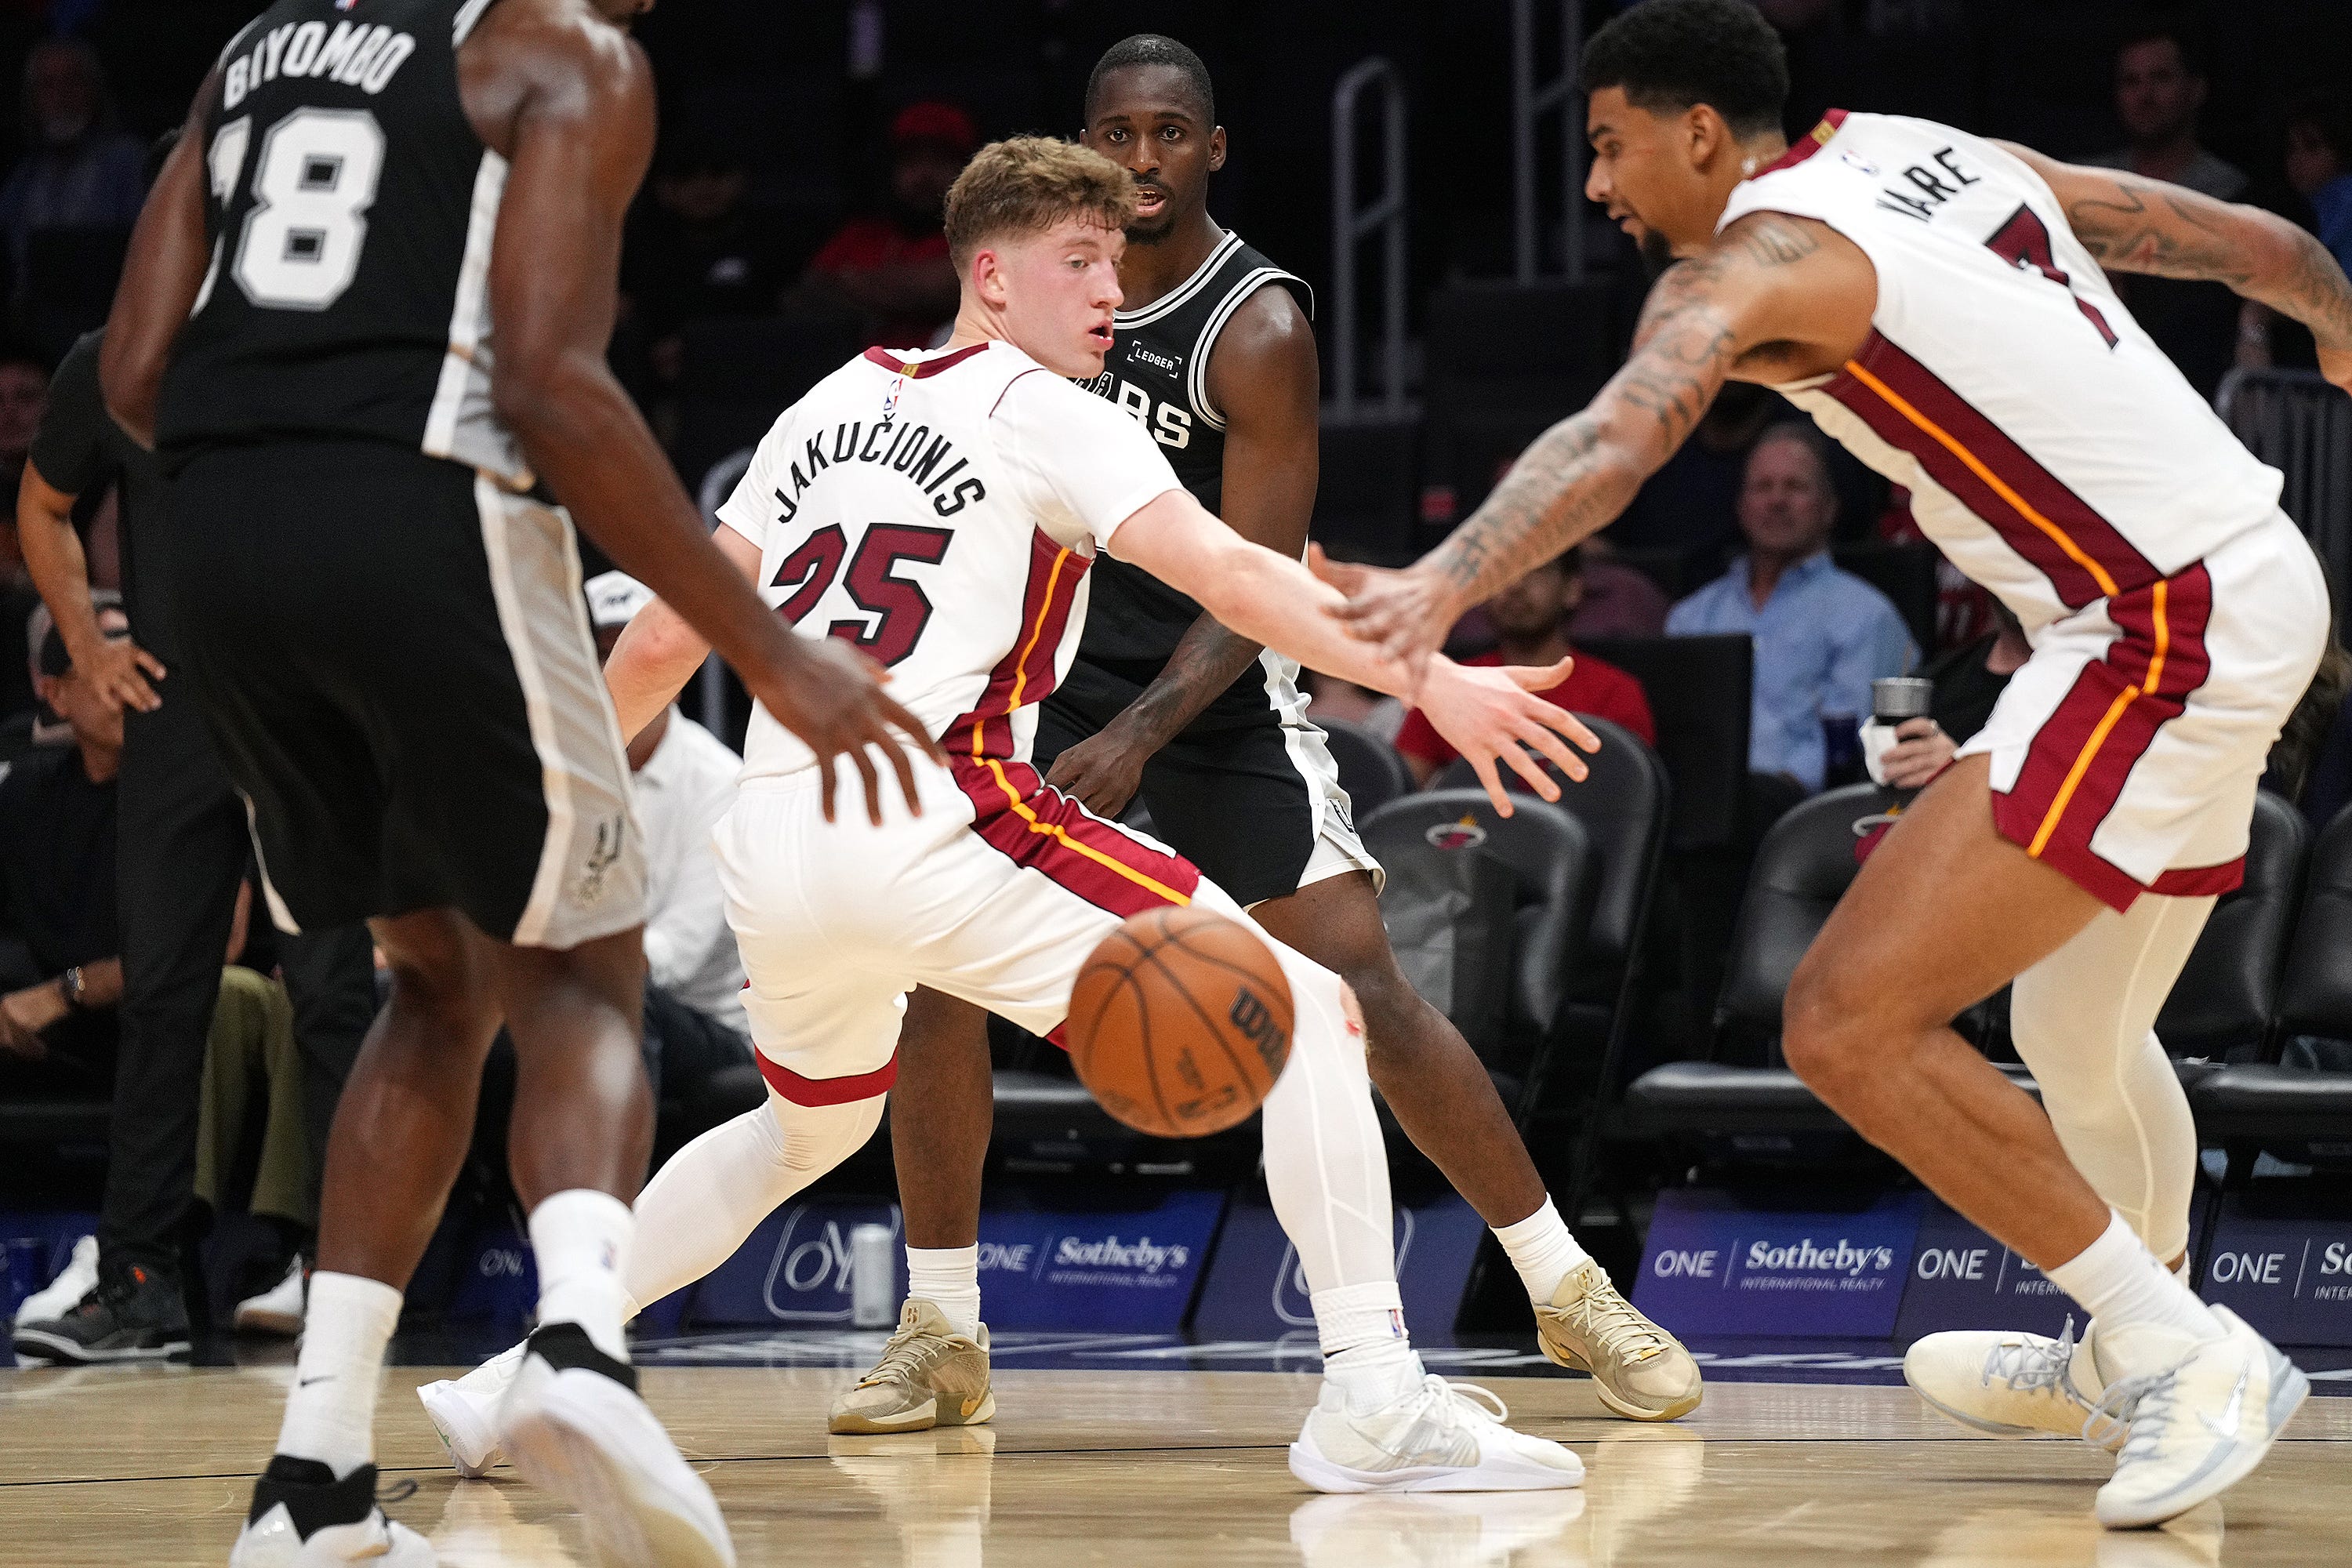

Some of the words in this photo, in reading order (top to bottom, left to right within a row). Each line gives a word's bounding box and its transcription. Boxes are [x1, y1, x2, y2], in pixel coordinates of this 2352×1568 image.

[224, 20, 416, 110] BIYOMBO
[1134, 347, 1175, 372] LEDGER
[775, 412, 986, 524] JAKUČIONIS
[769, 522, 956, 668] 25
[977, 1243, 1034, 1272] ONE
[1056, 1236, 1189, 1274] Sotheby's
[1654, 1249, 1719, 1278] ONE
[1745, 1238, 1893, 1276] Sotheby's
[1918, 1248, 1988, 1279] ONE
[2212, 1251, 2285, 1283] ONE
